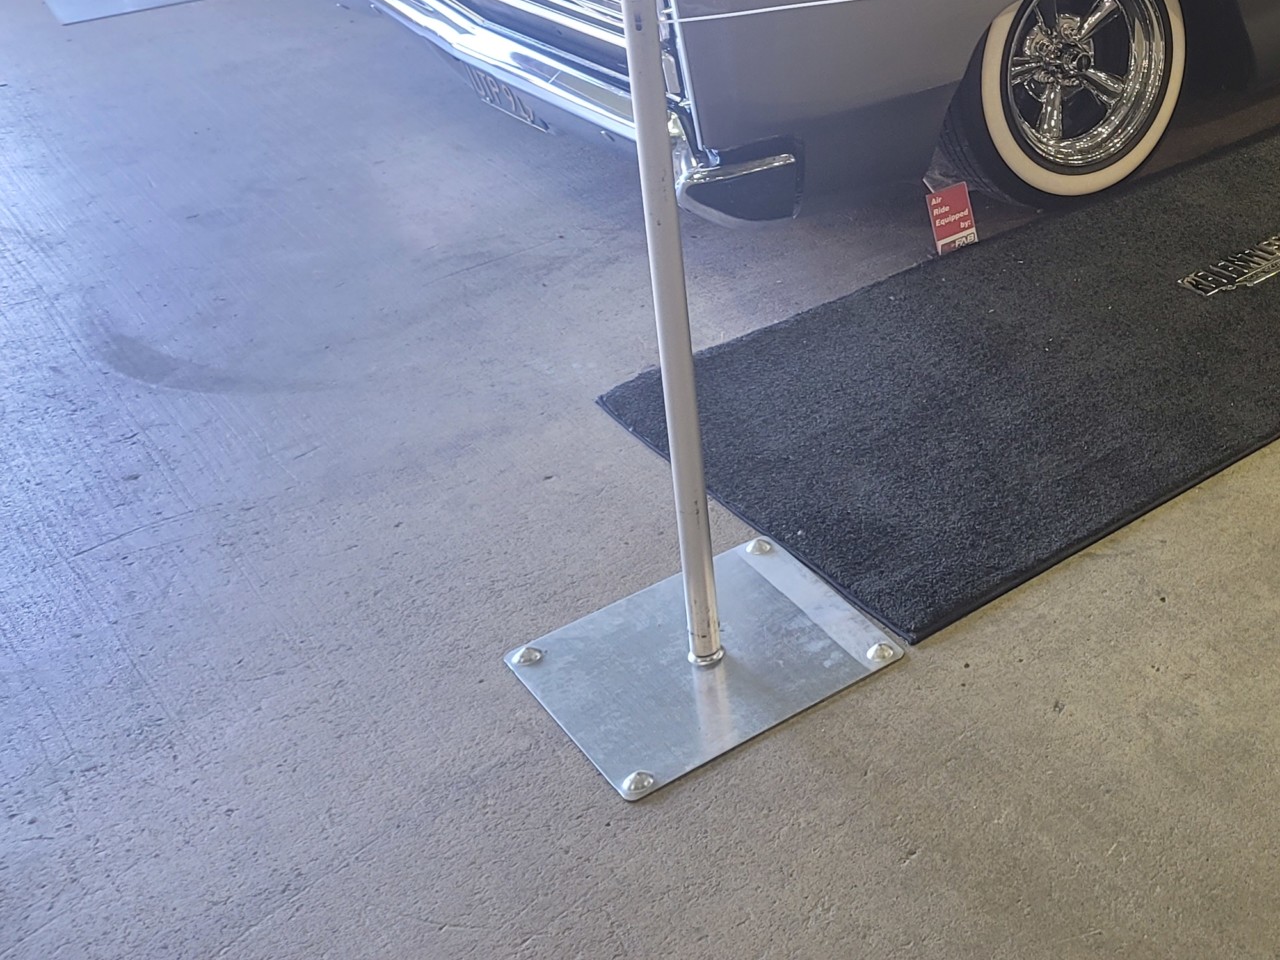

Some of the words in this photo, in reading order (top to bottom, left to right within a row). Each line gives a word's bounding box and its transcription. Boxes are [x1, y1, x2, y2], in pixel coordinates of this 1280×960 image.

[931, 196, 942, 206] Air
[933, 206, 950, 216] Ride
[935, 208, 969, 227] Equipped
